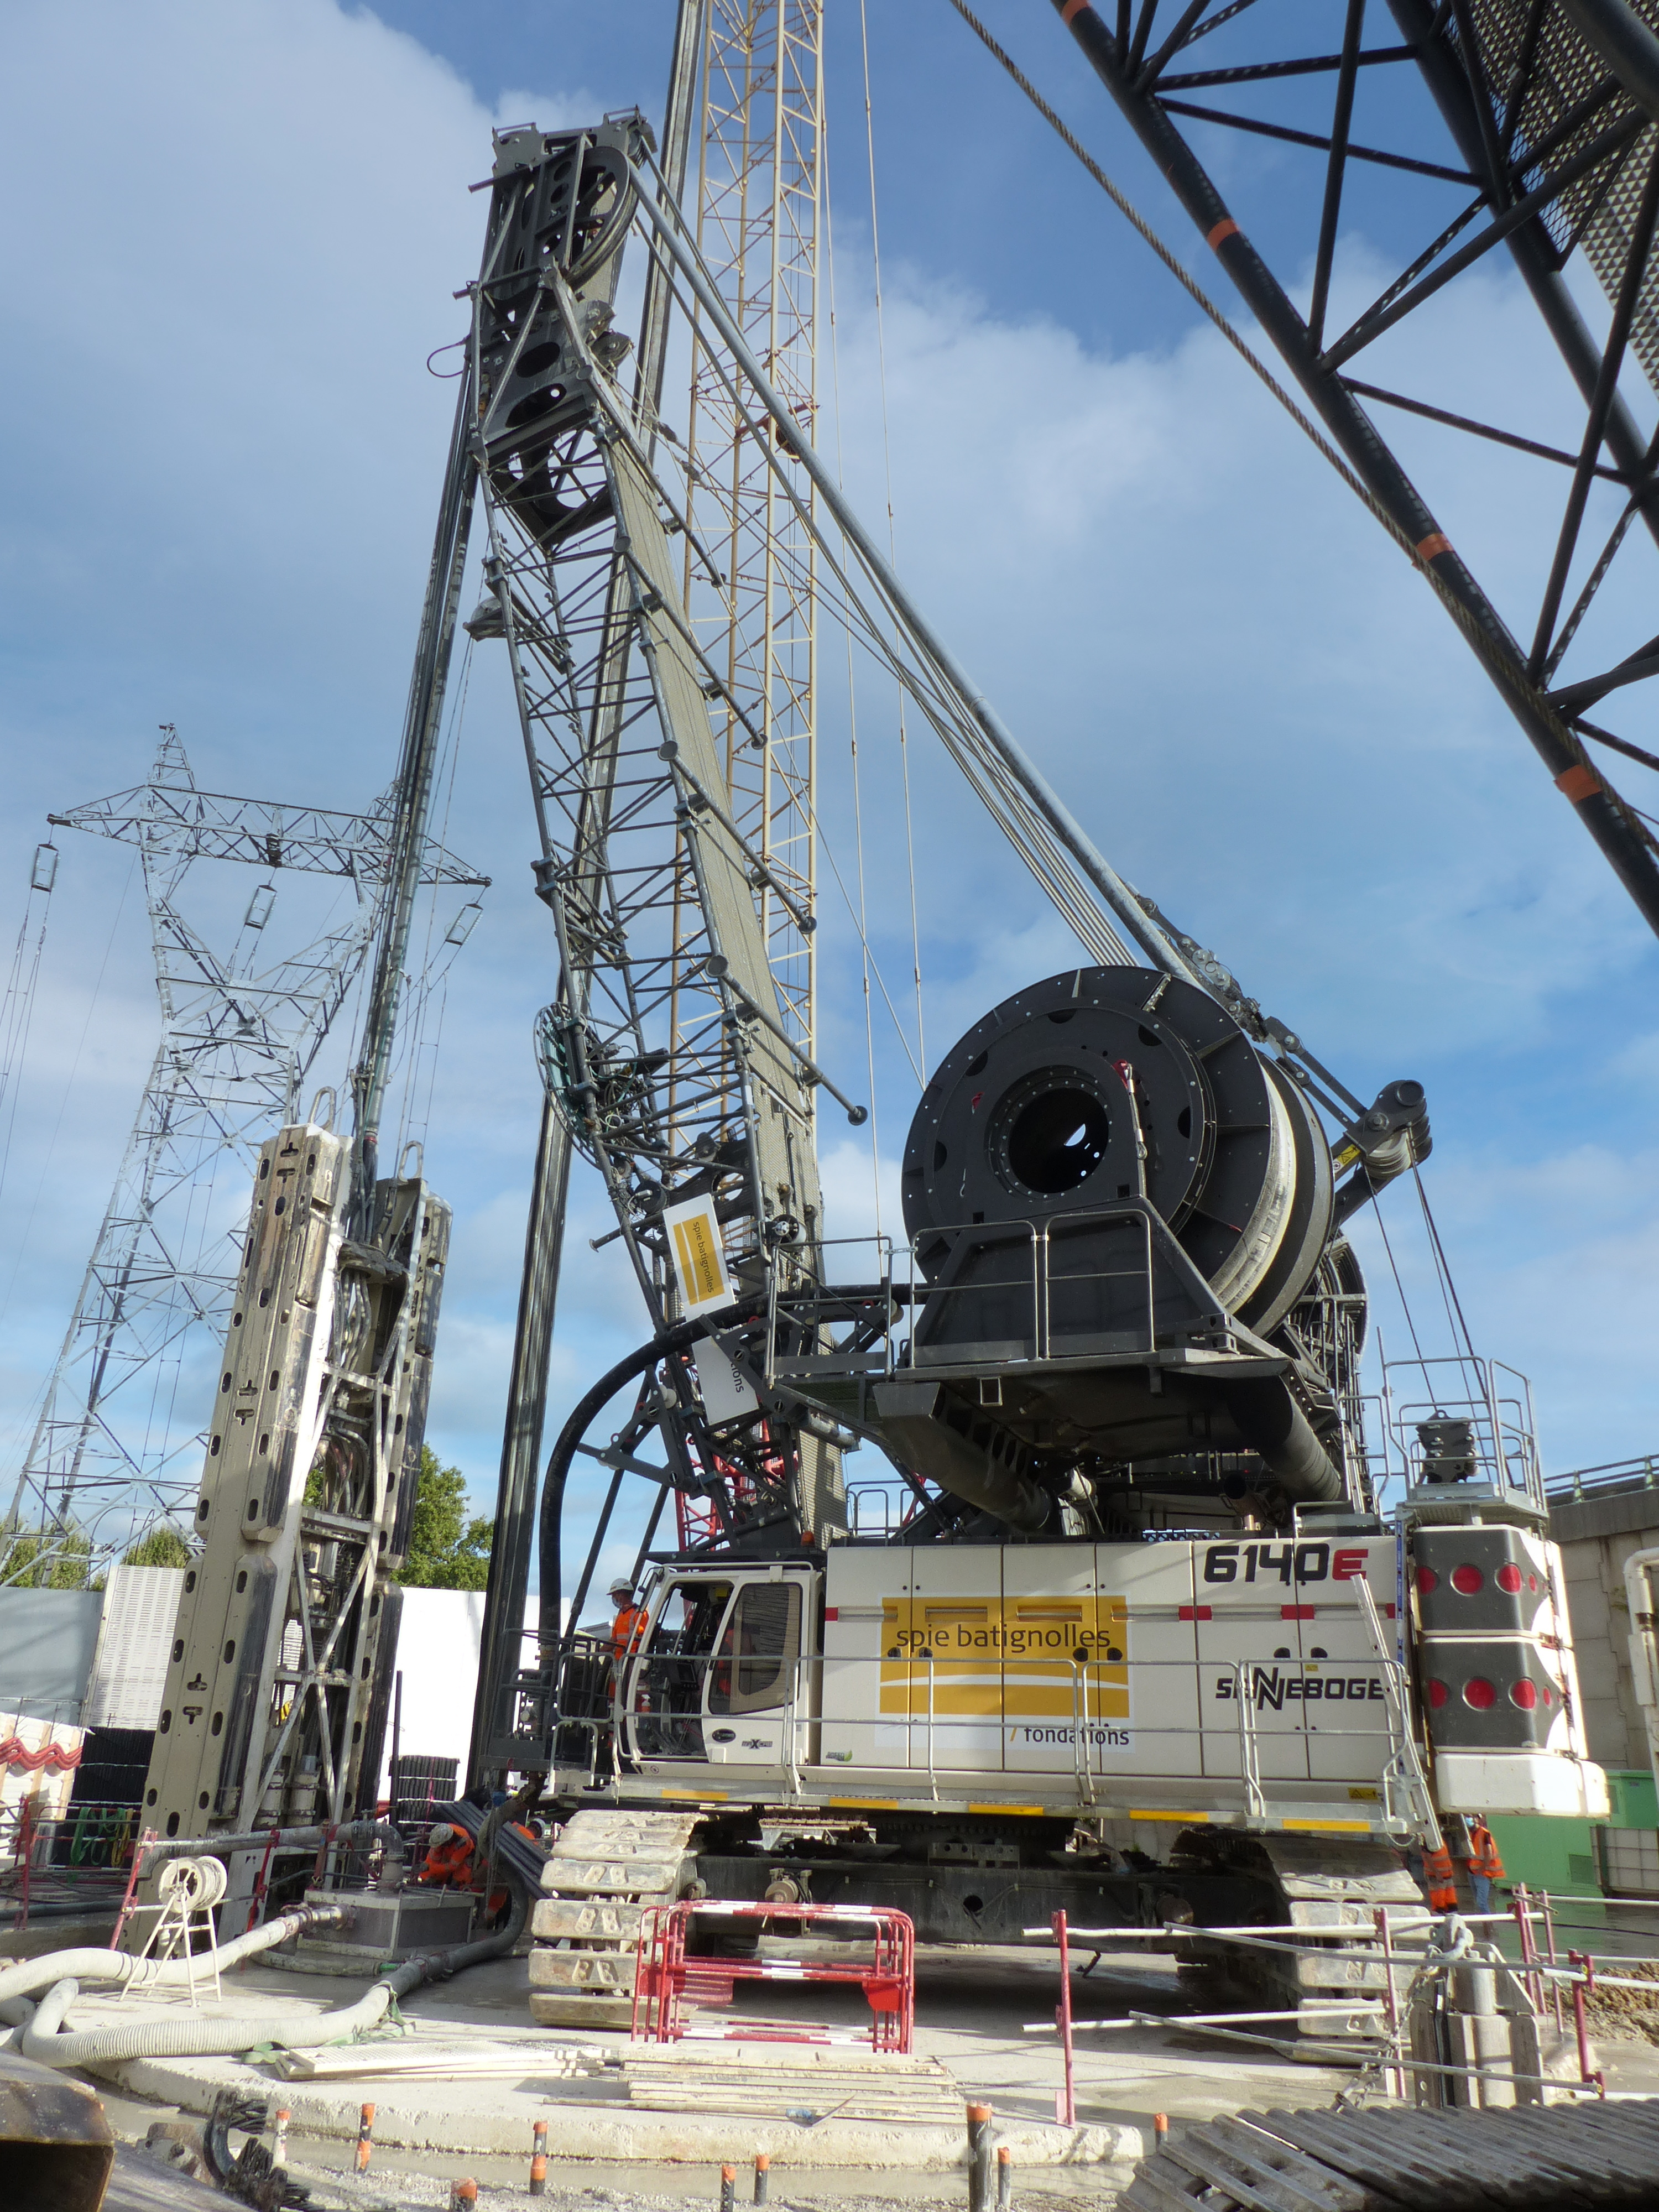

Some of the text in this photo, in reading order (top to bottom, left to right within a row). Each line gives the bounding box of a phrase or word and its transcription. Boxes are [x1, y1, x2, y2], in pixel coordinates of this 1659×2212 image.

[693, 1222, 714, 1293] spie batignolles
[896, 1624, 1111, 1653] spie batignolles
[1215, 1667, 1385, 1710] SENNEBOGE
[1024, 1725, 1130, 1745] fondations
